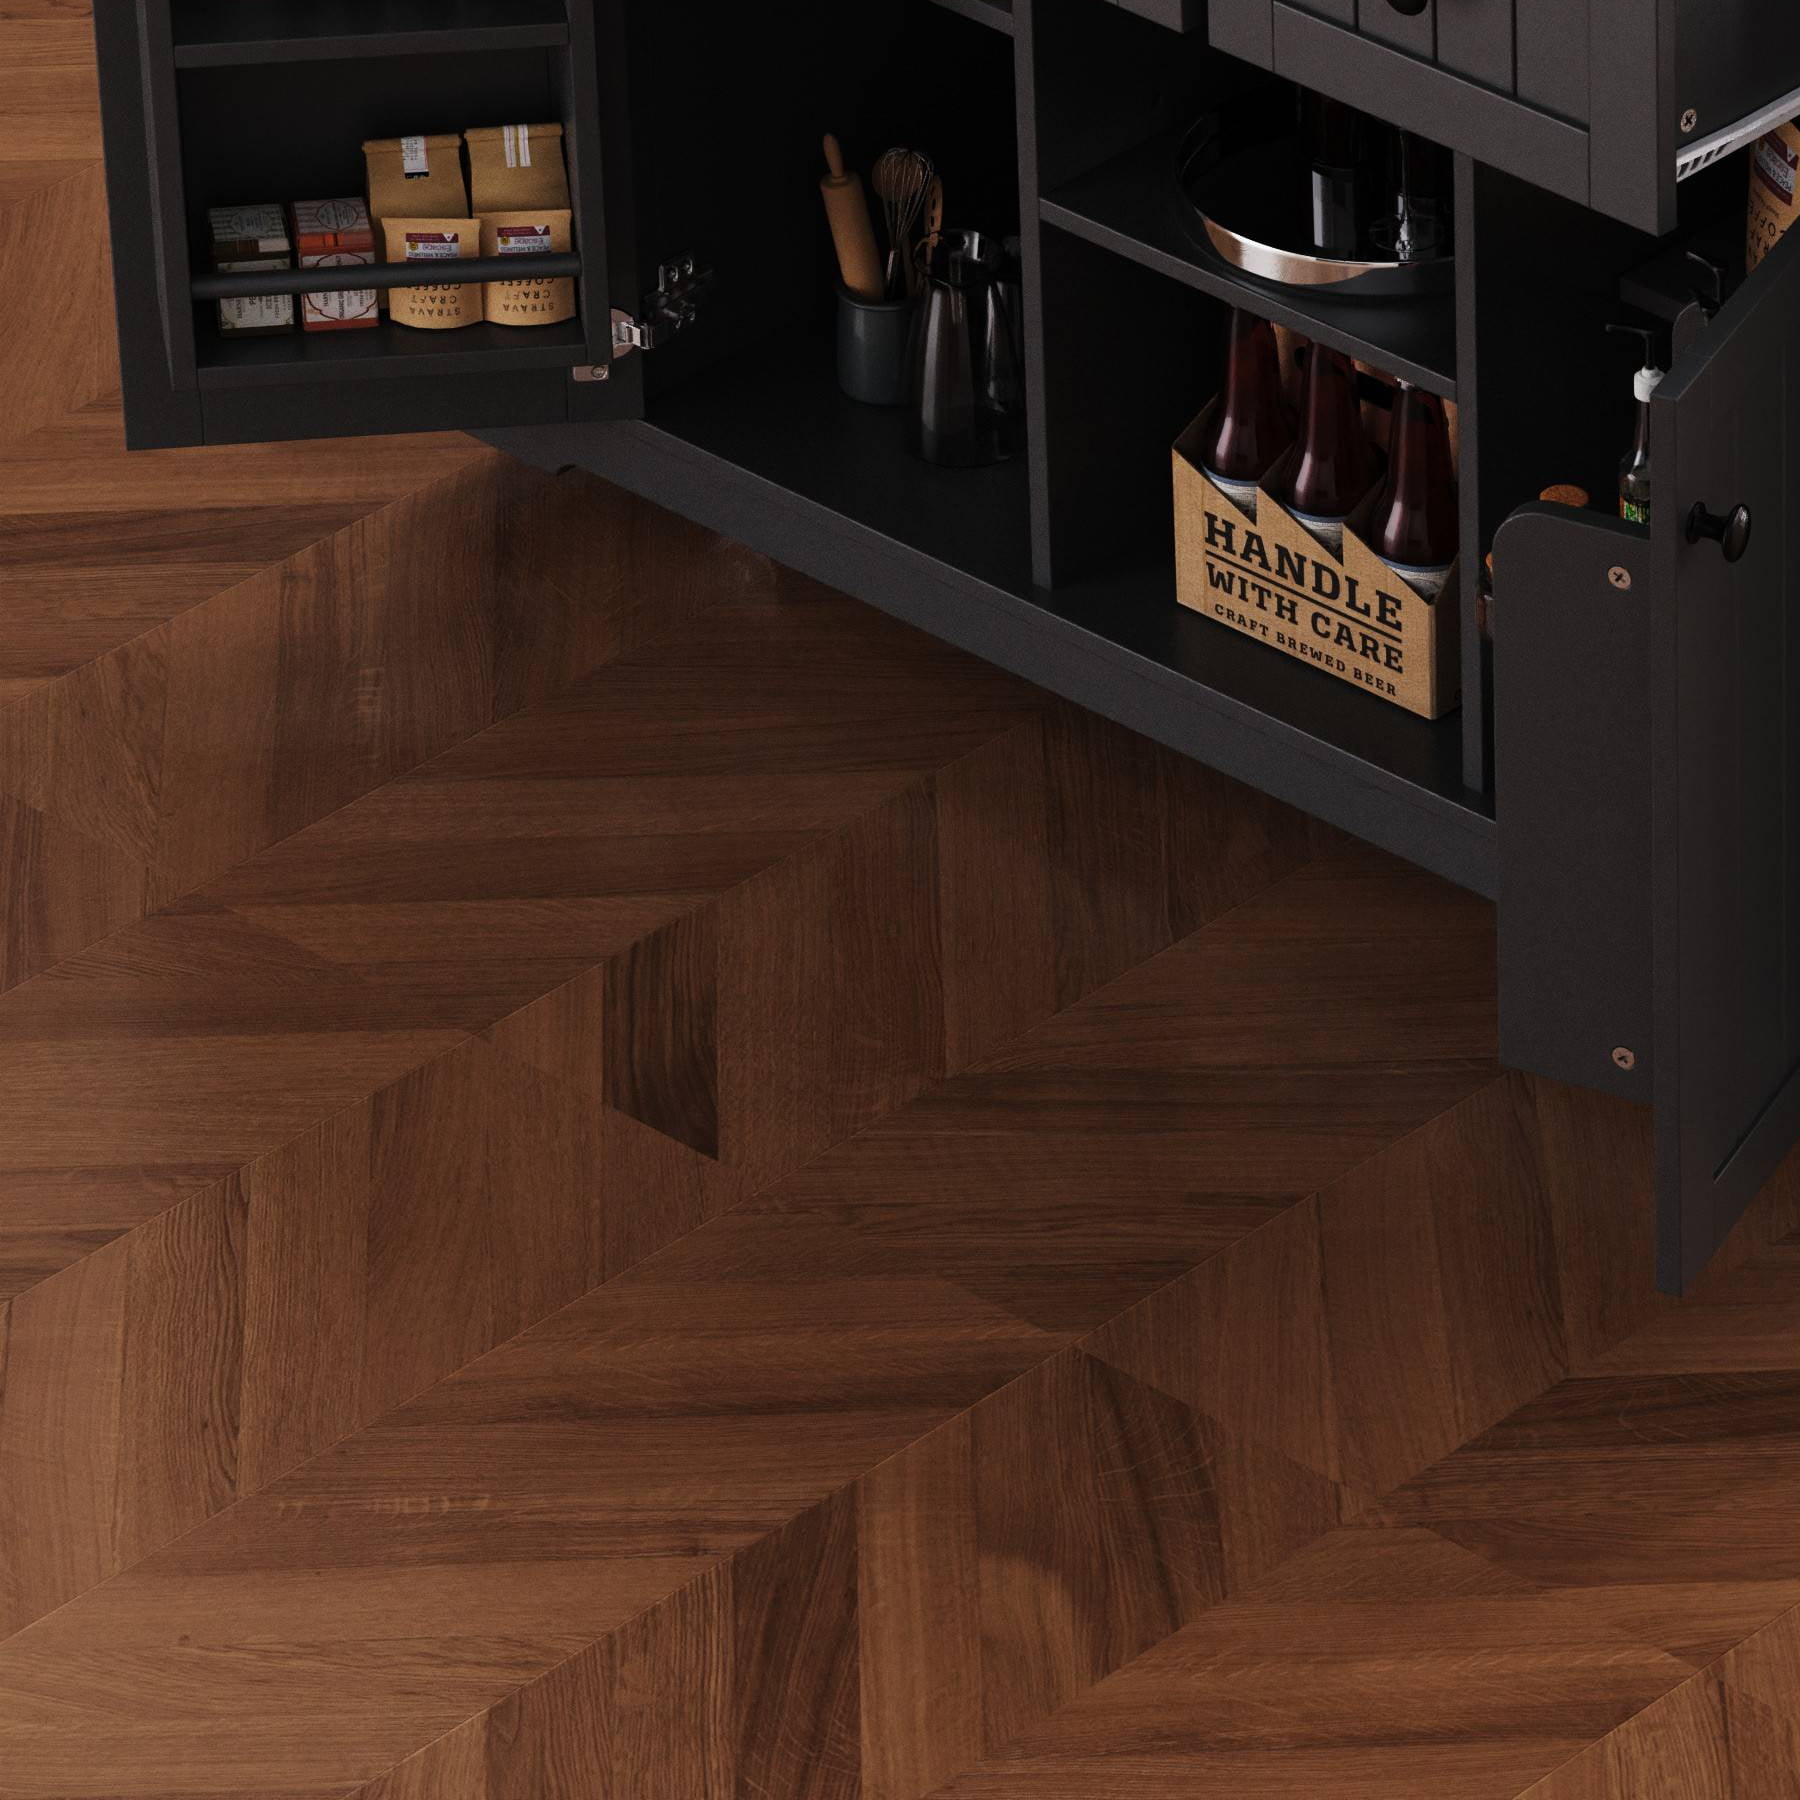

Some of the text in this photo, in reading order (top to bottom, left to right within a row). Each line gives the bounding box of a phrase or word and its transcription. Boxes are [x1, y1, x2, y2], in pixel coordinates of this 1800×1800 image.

[409, 307, 461, 317] STRAVA
[411, 295, 457, 304] CRAFT
[502, 302, 554, 312] STRAVA
[1203, 510, 1403, 633] HANDLE
[1206, 561, 1404, 675] WITH CARE
[1214, 603, 1397, 697] CRAFT BREWED BEER
